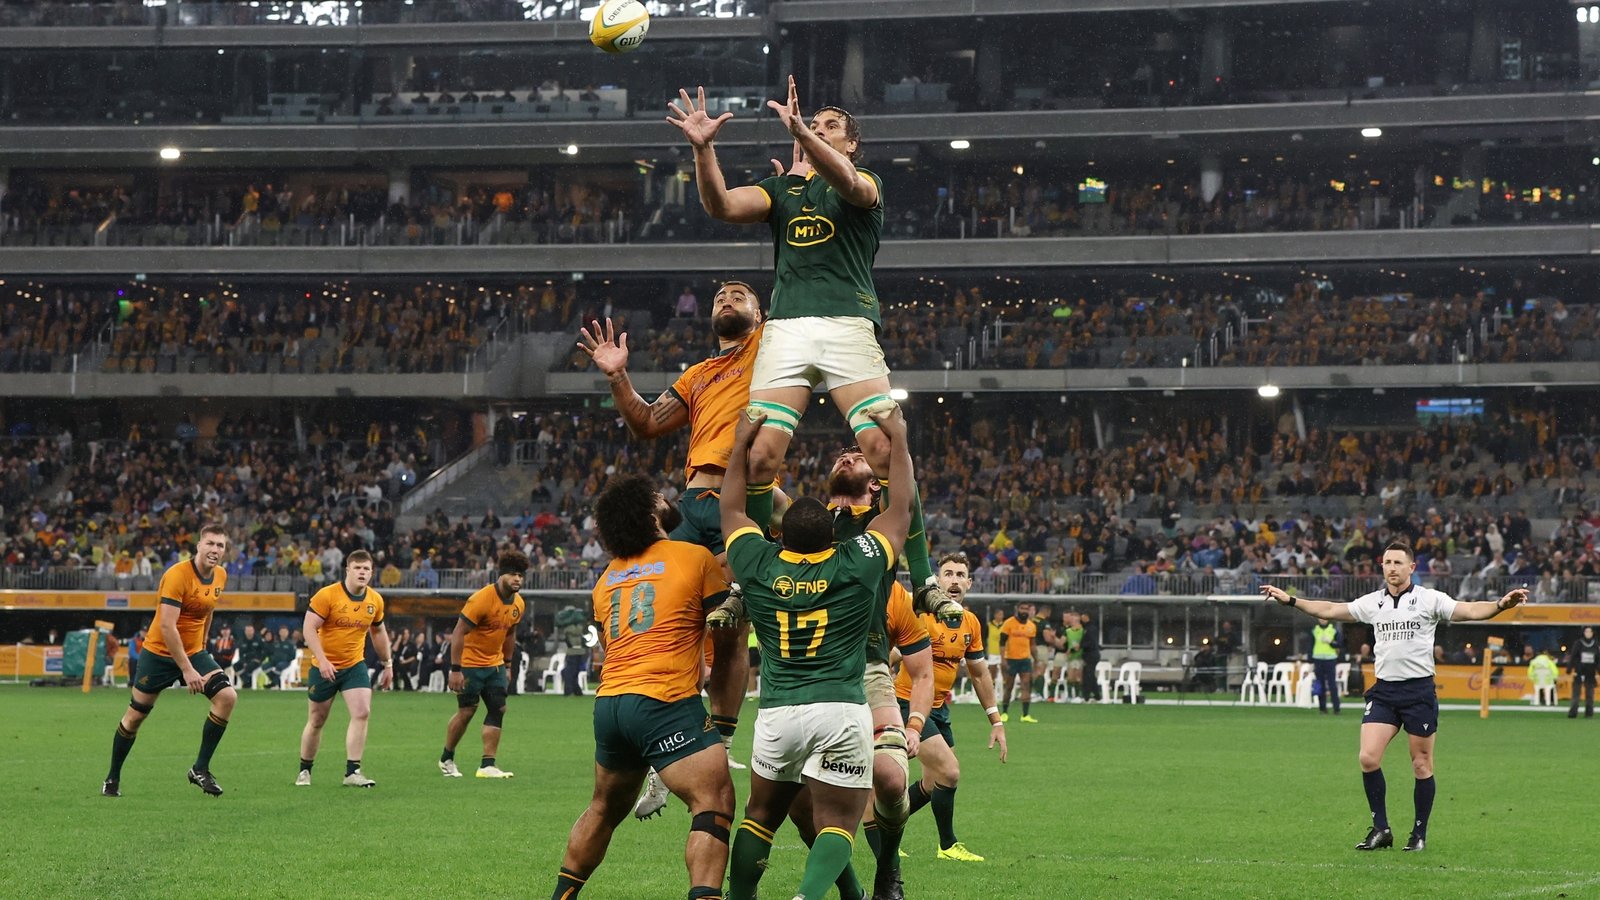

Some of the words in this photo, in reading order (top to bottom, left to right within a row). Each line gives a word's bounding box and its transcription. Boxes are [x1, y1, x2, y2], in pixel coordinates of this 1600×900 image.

[796, 580, 828, 594] FNB
[610, 582, 655, 640] 18
[776, 608, 829, 658] 17
[1376, 619, 1421, 633] Emirates
[1392, 630, 1415, 641] BETTER
[658, 731, 685, 752] IHG
[821, 757, 866, 777] betway
